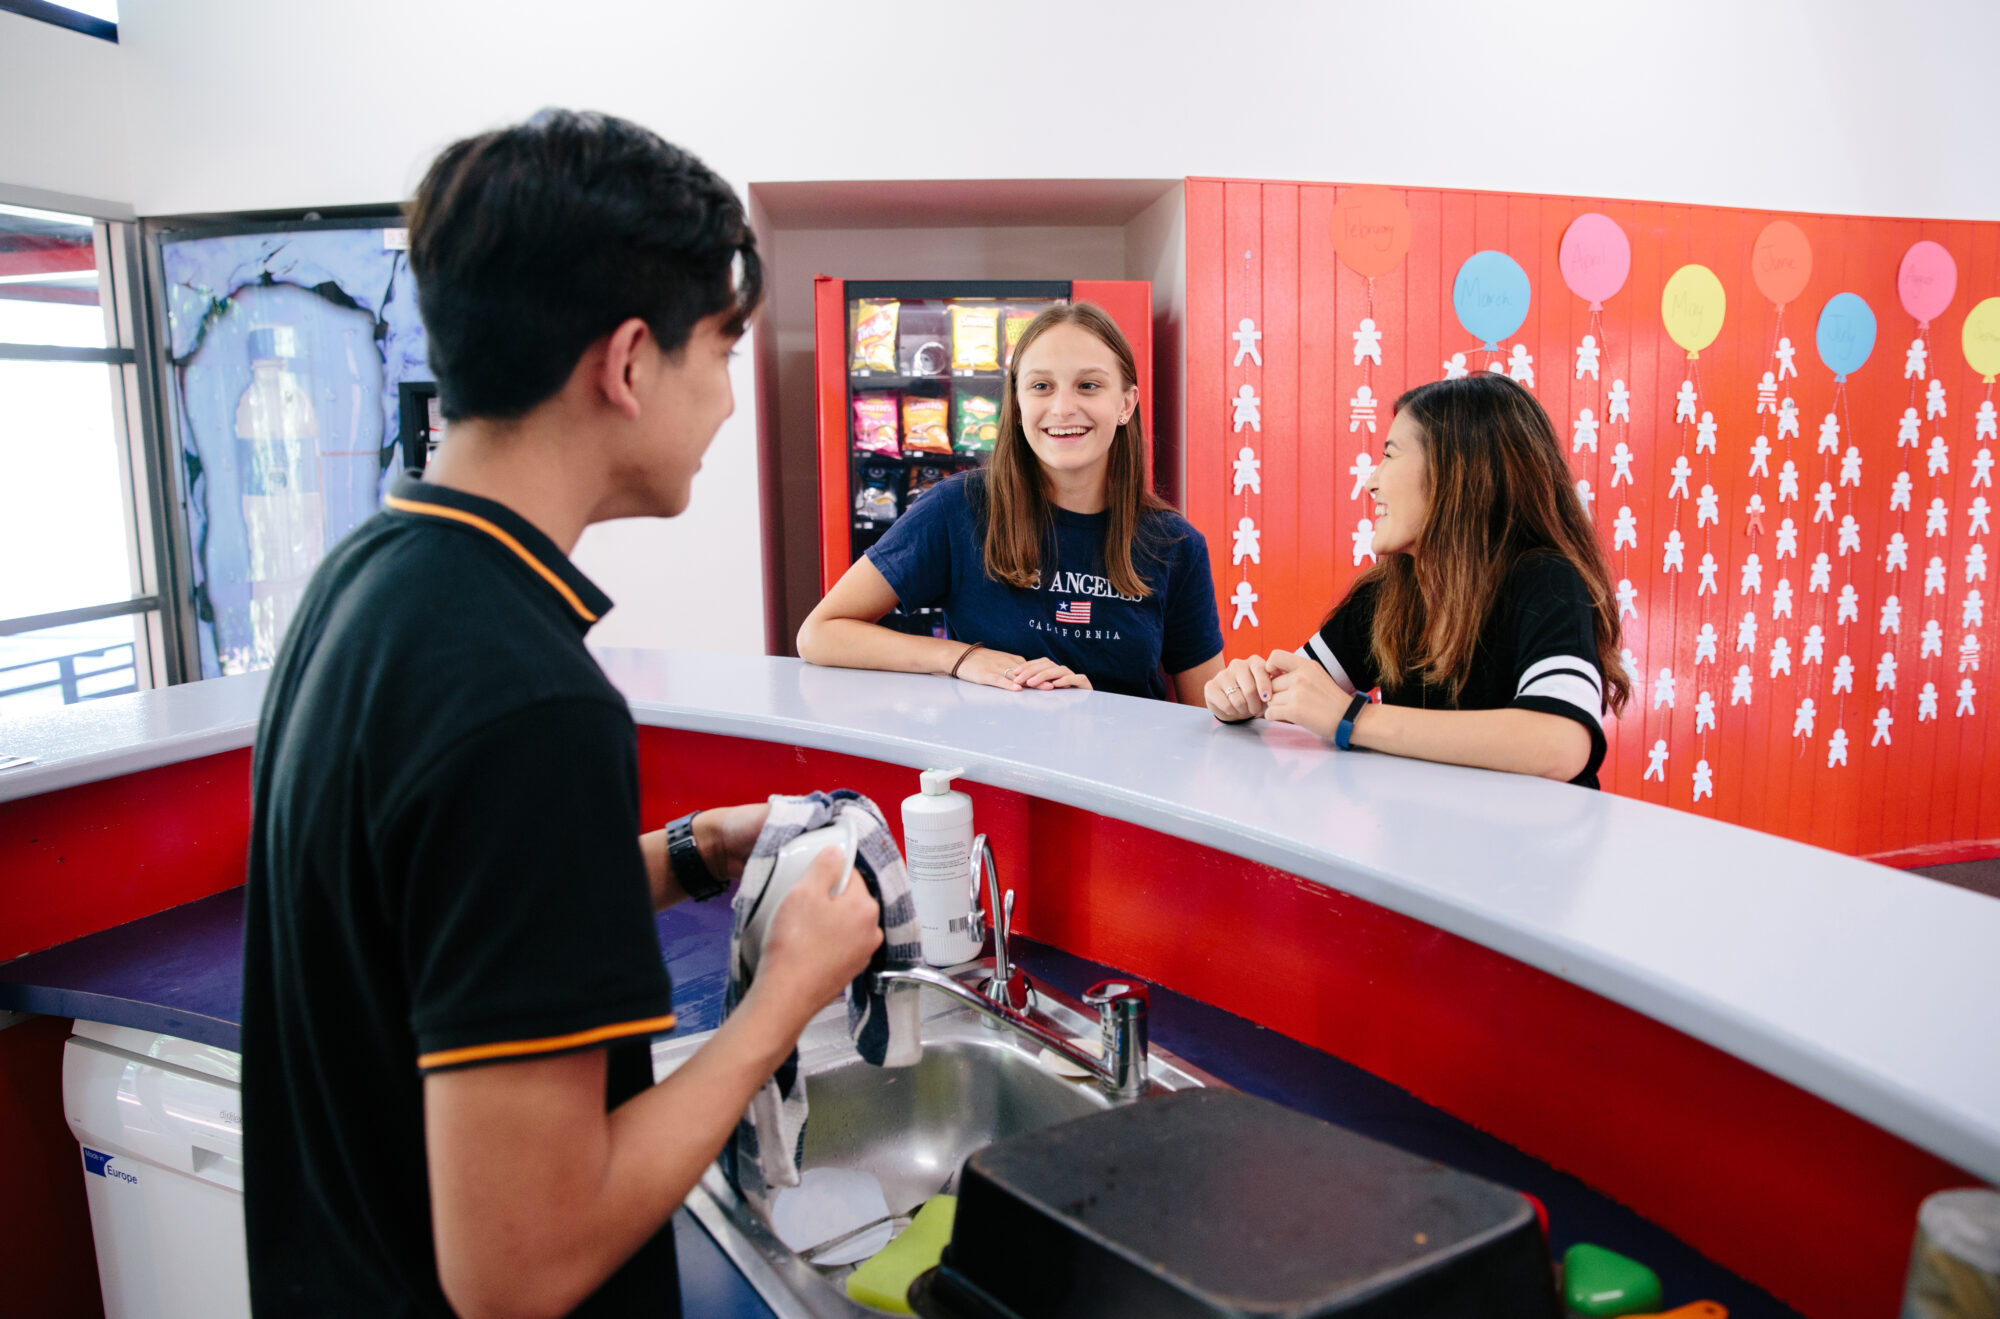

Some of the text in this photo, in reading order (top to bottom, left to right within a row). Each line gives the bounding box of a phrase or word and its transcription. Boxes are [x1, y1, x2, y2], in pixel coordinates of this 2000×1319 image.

[1460, 276, 1513, 308] March
[1671, 289, 1704, 338] May
[1028, 618, 1121, 640] CALIFORNIA
[106, 1164, 138, 1185] Europe
